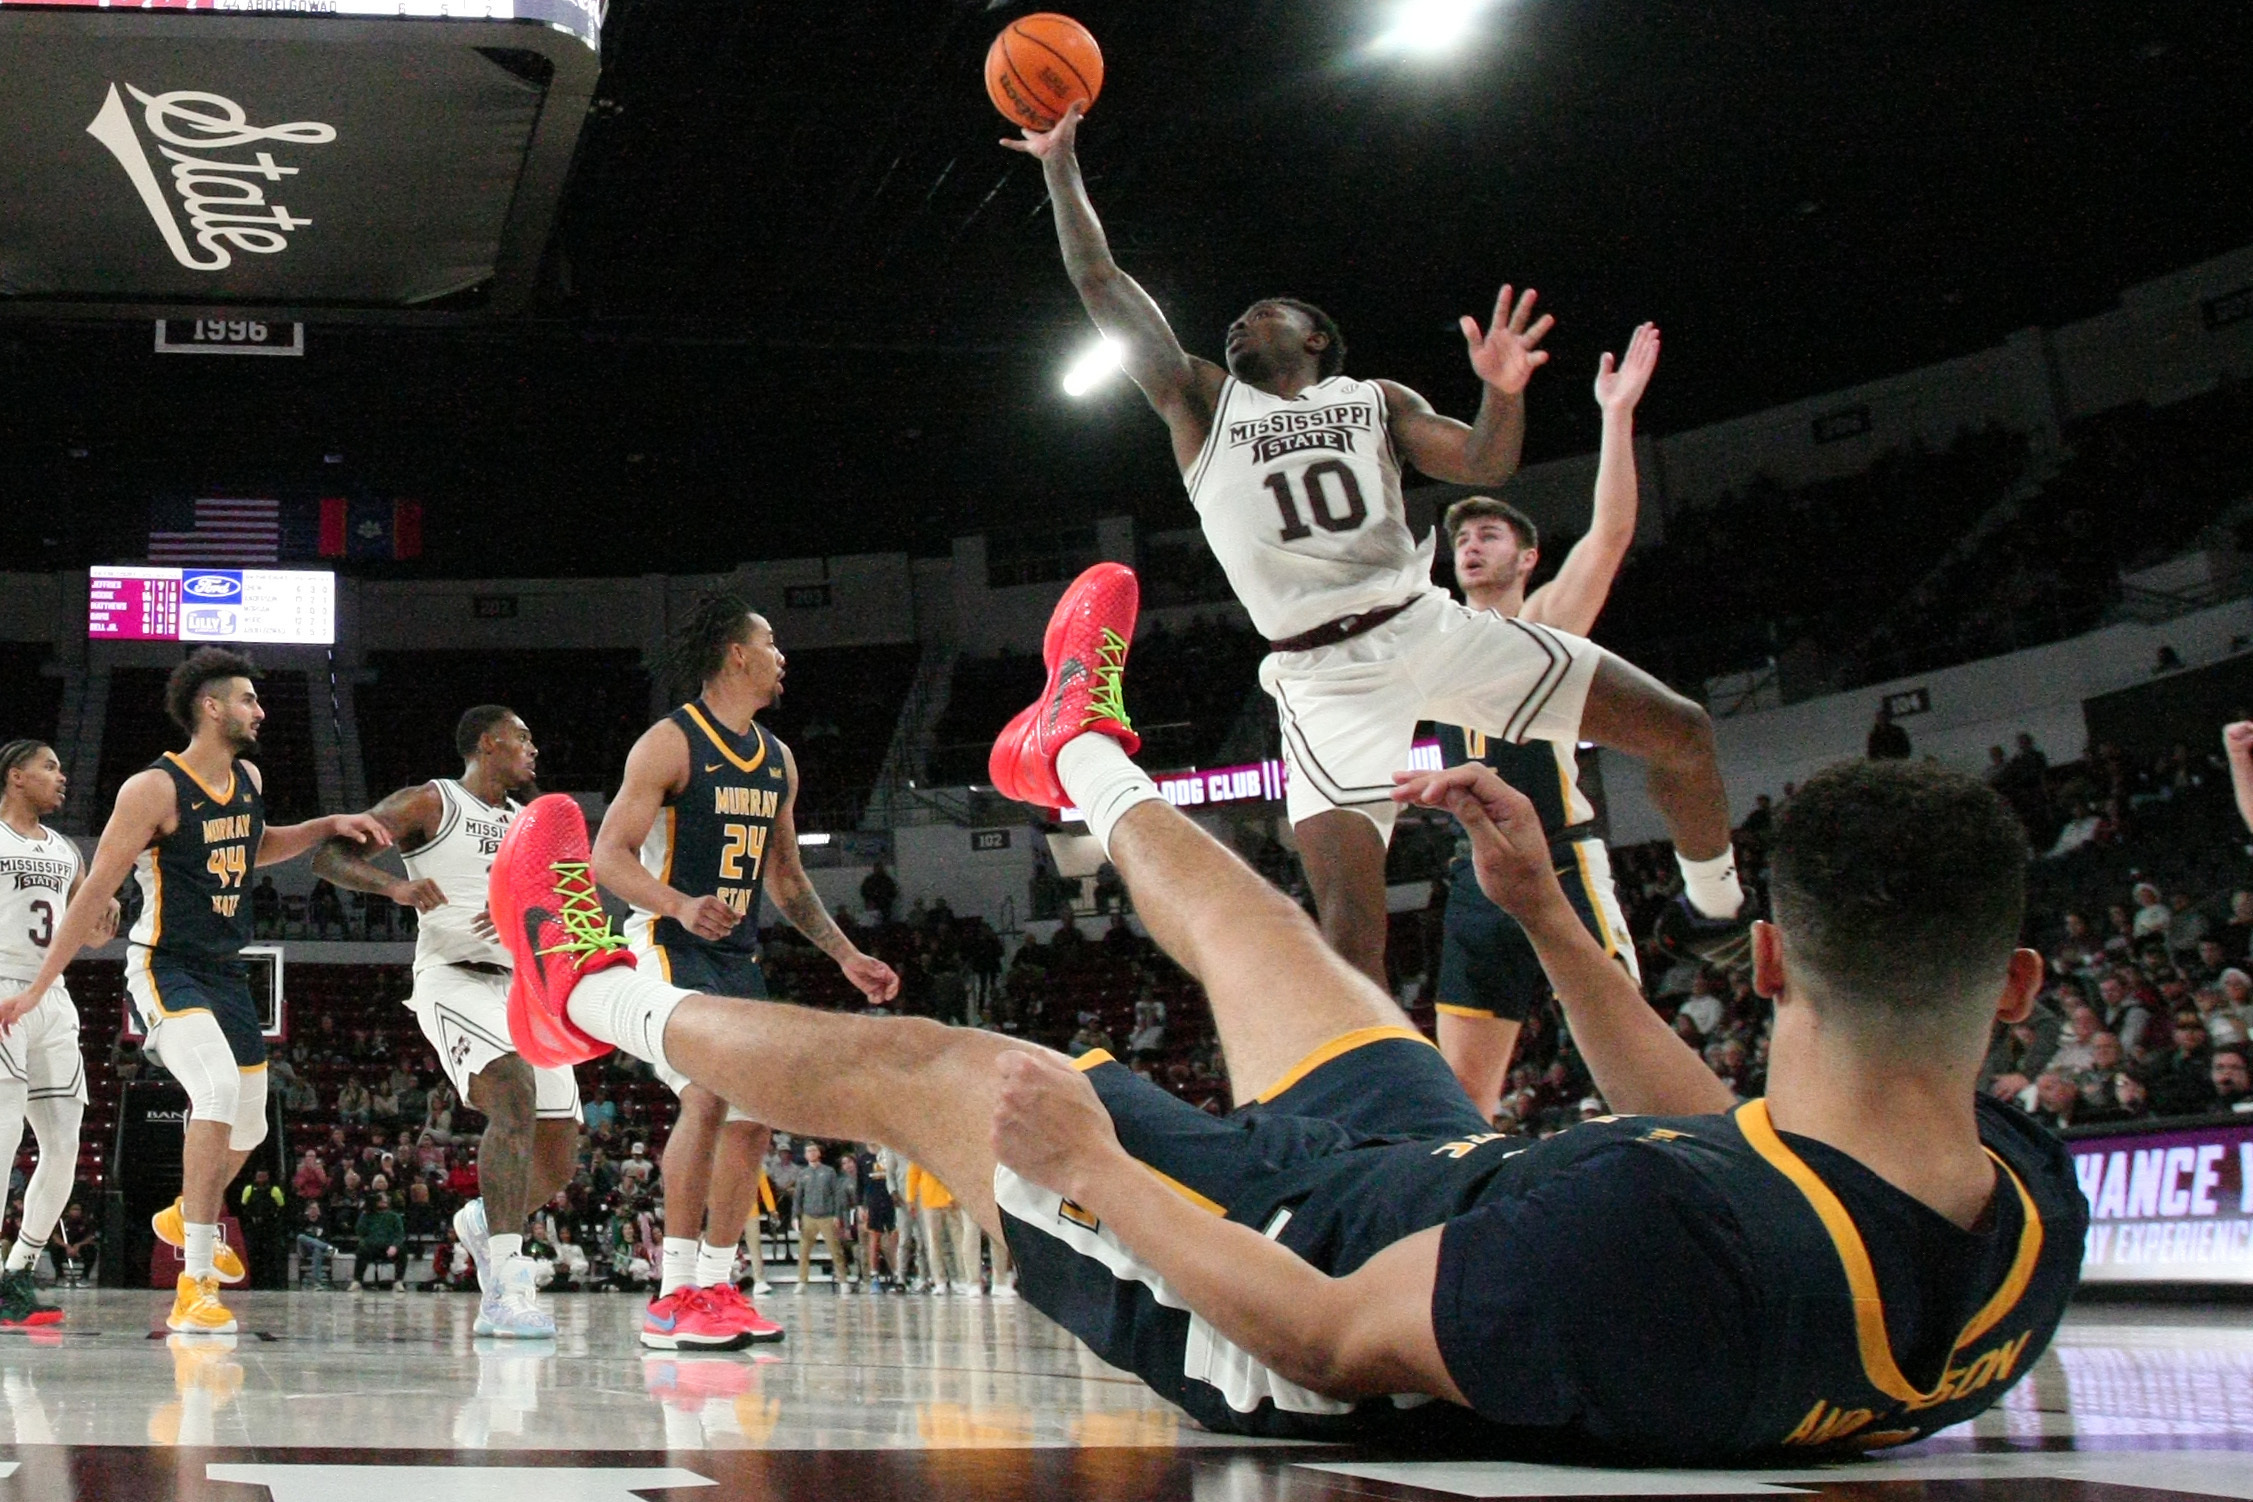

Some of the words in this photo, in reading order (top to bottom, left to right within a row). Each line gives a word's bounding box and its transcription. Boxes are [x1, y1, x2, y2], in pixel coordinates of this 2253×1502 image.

[86, 82, 336, 271] State
[194, 320, 268, 341] 1996
[1230, 406, 1371, 444] MISSISSIPPI
[1268, 431, 1339, 456] STATE
[1263, 459, 1370, 543] 10
[194, 578, 230, 594] Ford
[715, 786, 778, 818] MURRAY
[1154, 778, 1205, 806] DOG
[1208, 770, 1261, 802] CLUB
[466, 820, 507, 839] MISSI
[980, 834, 1003, 848] 102
[207, 845, 247, 888] 44
[719, 823, 767, 881] 24
[23, 876, 59, 890] STATE
[29, 900, 53, 948] 3
[2114, 1218, 2253, 1264] EXPERIENC
